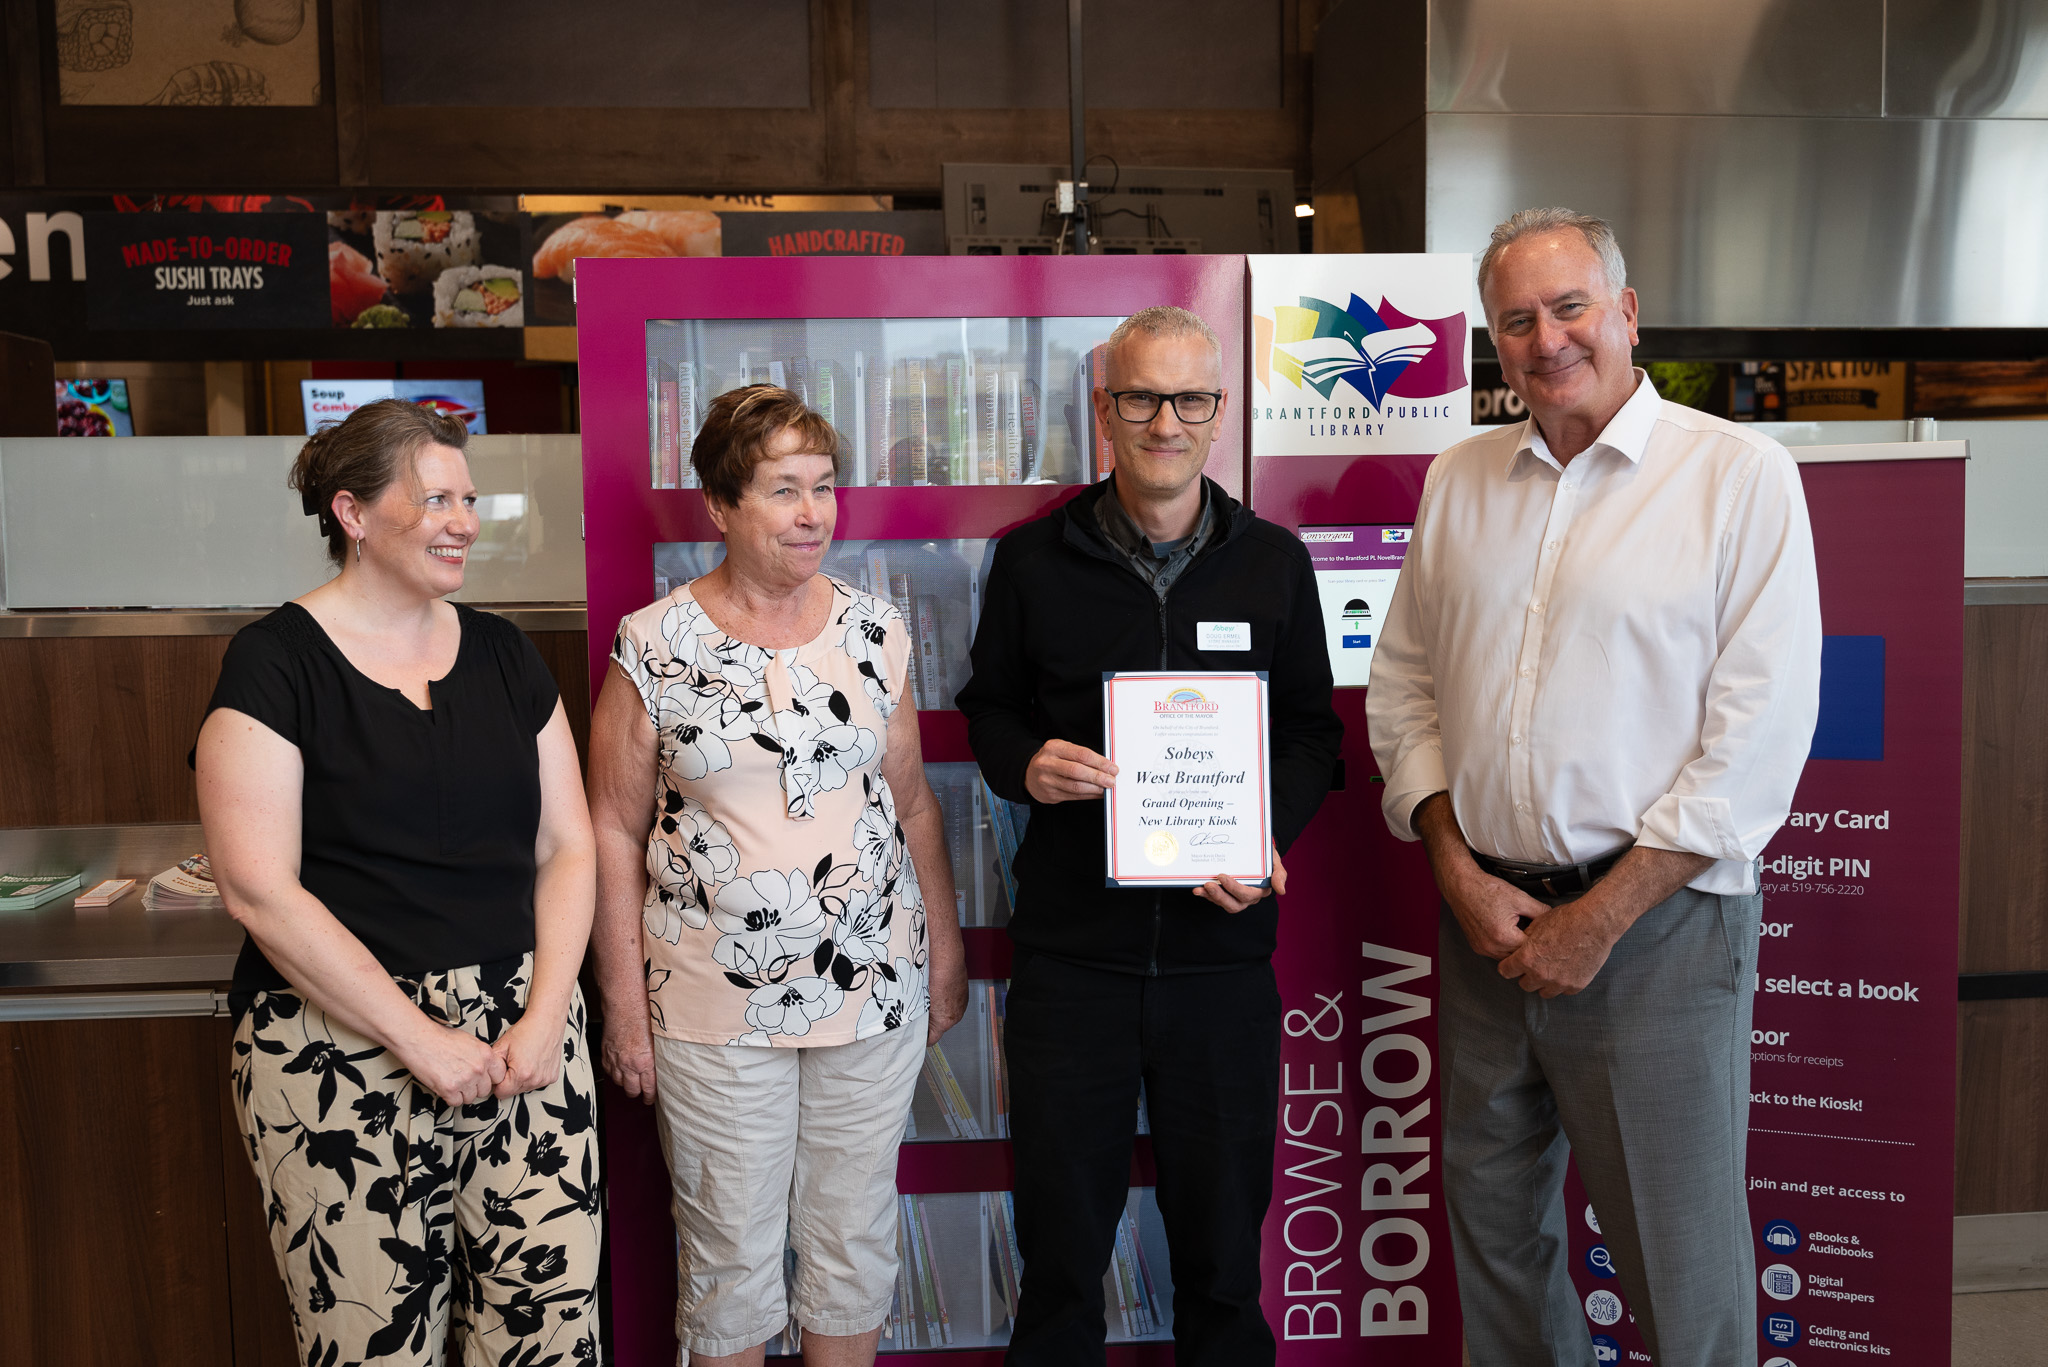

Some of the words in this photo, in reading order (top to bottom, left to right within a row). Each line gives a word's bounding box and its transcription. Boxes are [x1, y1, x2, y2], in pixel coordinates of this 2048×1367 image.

[768, 229, 905, 257] HANDCRAFTED
[121, 235, 293, 269] MADE-TO-ORDER
[154, 266, 206, 290] SUSHI
[209, 266, 264, 290] TRAYS
[187, 295, 210, 306] Just
[213, 295, 235, 307] ask
[681, 366, 690, 383] ALL
[311, 388, 345, 399] Soup
[985, 375, 994, 409] DAVID
[681, 385, 691, 417] FOURS
[1023, 396, 1034, 421] NEVER
[1473, 388, 1526, 424] pro
[1252, 406, 1371, 421] BRANTFORD
[1387, 405, 1450, 419] PUBLIC
[1007, 412, 1019, 449] Health
[1310, 423, 1385, 437] LIBRARY
[1008, 451, 1019, 469] for
[1300, 532, 1353, 541] Convergent
[1154, 701, 1219, 711] BRANTFORD
[1164, 746, 1214, 763] Sobeys
[1136, 771, 1170, 784] West
[1175, 770, 1246, 787] Brantford
[1142, 798, 1176, 808] Grand
[1179, 798, 1224, 810] Opening
[1139, 816, 1163, 826] New
[1165, 816, 1205, 828] Library
[1208, 816, 1238, 826] Kiosk
[1834, 810, 1890, 830] Card
[1829, 858, 1870, 878] PIN
[1780, 883, 1789, 892] at
[1791, 882, 1864, 895] 519-756-2220
[1765, 975, 1833, 997] select
[1838, 984, 1852, 997] a
[1858, 979, 1919, 1002] book
[1284, 990, 1343, 1042] &
[1750, 1029, 1790, 1046] oor
[1787, 1052, 1802, 1064] for
[1803, 1054, 1844, 1069] receipts
[1773, 1094, 1789, 1105] to
[1792, 1095, 1817, 1108] the
[1819, 1096, 1863, 1112] Kiosk!
[1359, 941, 1432, 1337] BORROW
[1749, 1177, 1777, 1191] join
[1780, 1179, 1809, 1193] and
[1811, 1183, 1835, 1197] get
[1838, 1187, 1886, 1201] access
[1889, 1190, 1906, 1203] to
[1284, 1061, 1343, 1340] BROWSE
[1808, 1231, 1849, 1244] eBooks
[1850, 1235, 1860, 1245] &
[1808, 1242, 1874, 1259] Audiobooks
[1808, 1274, 1844, 1288] Digital
[1808, 1286, 1875, 1303] newspapers
[1808, 1325, 1845, 1340] Coding
[1847, 1329, 1870, 1341] and
[1808, 1336, 1868, 1353] electronics
[1870, 1343, 1891, 1356] kits
